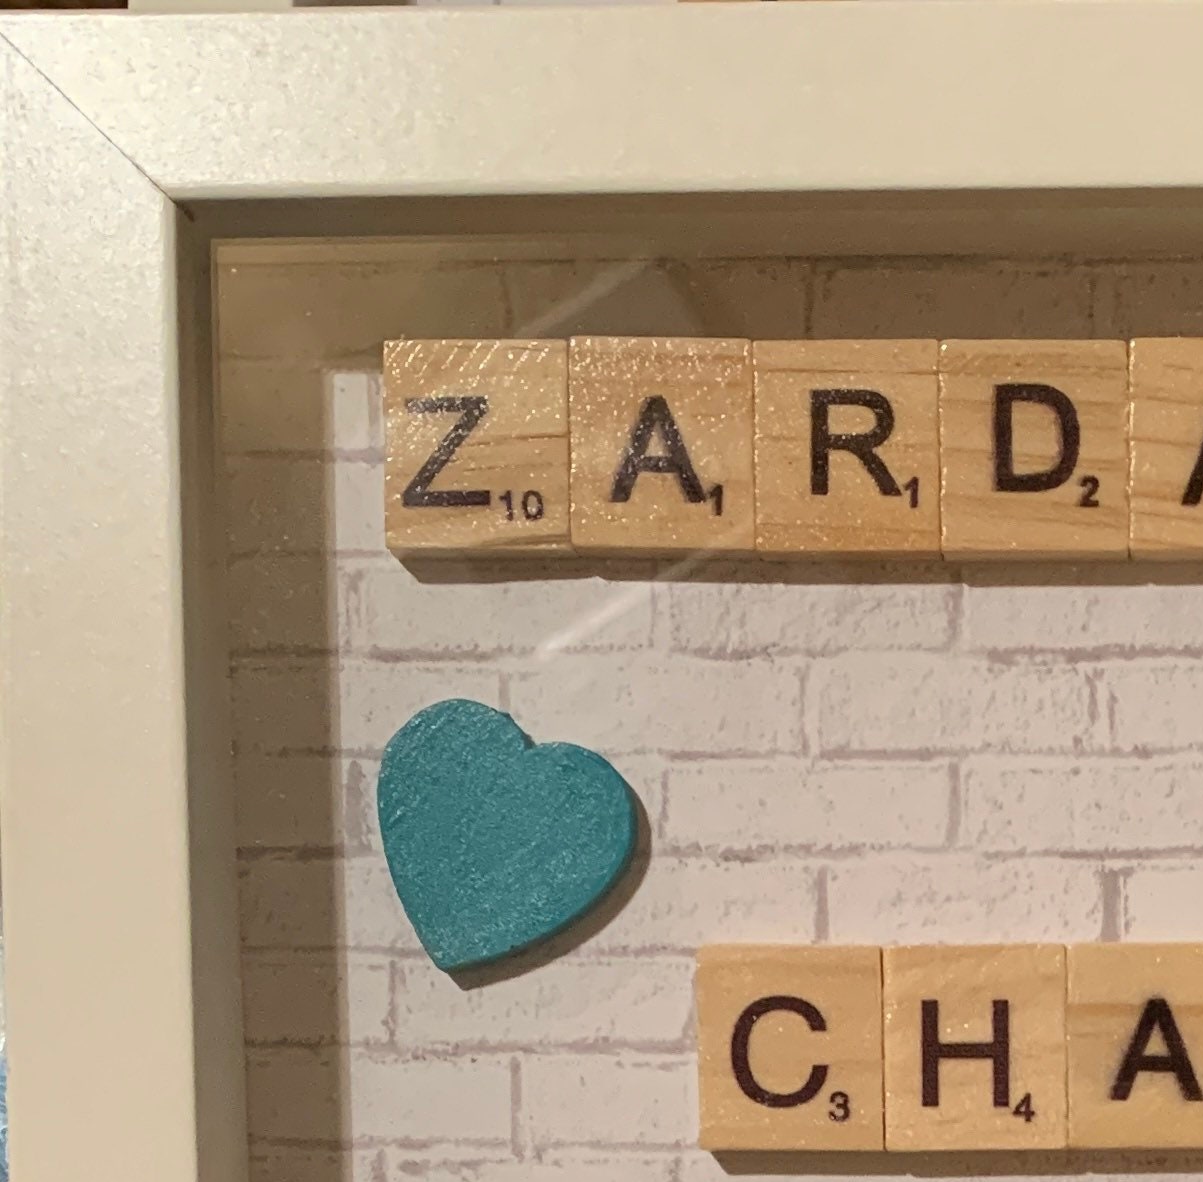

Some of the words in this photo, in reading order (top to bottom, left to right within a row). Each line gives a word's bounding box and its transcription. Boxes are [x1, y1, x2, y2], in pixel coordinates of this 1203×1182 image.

[498, 490, 545, 521] 10
[706, 484, 725, 516] 1
[903, 476, 921, 509] 1
[1078, 475, 1101, 508] 2
[827, 1091, 852, 1122] 3
[1011, 1093, 1036, 1123] 4
